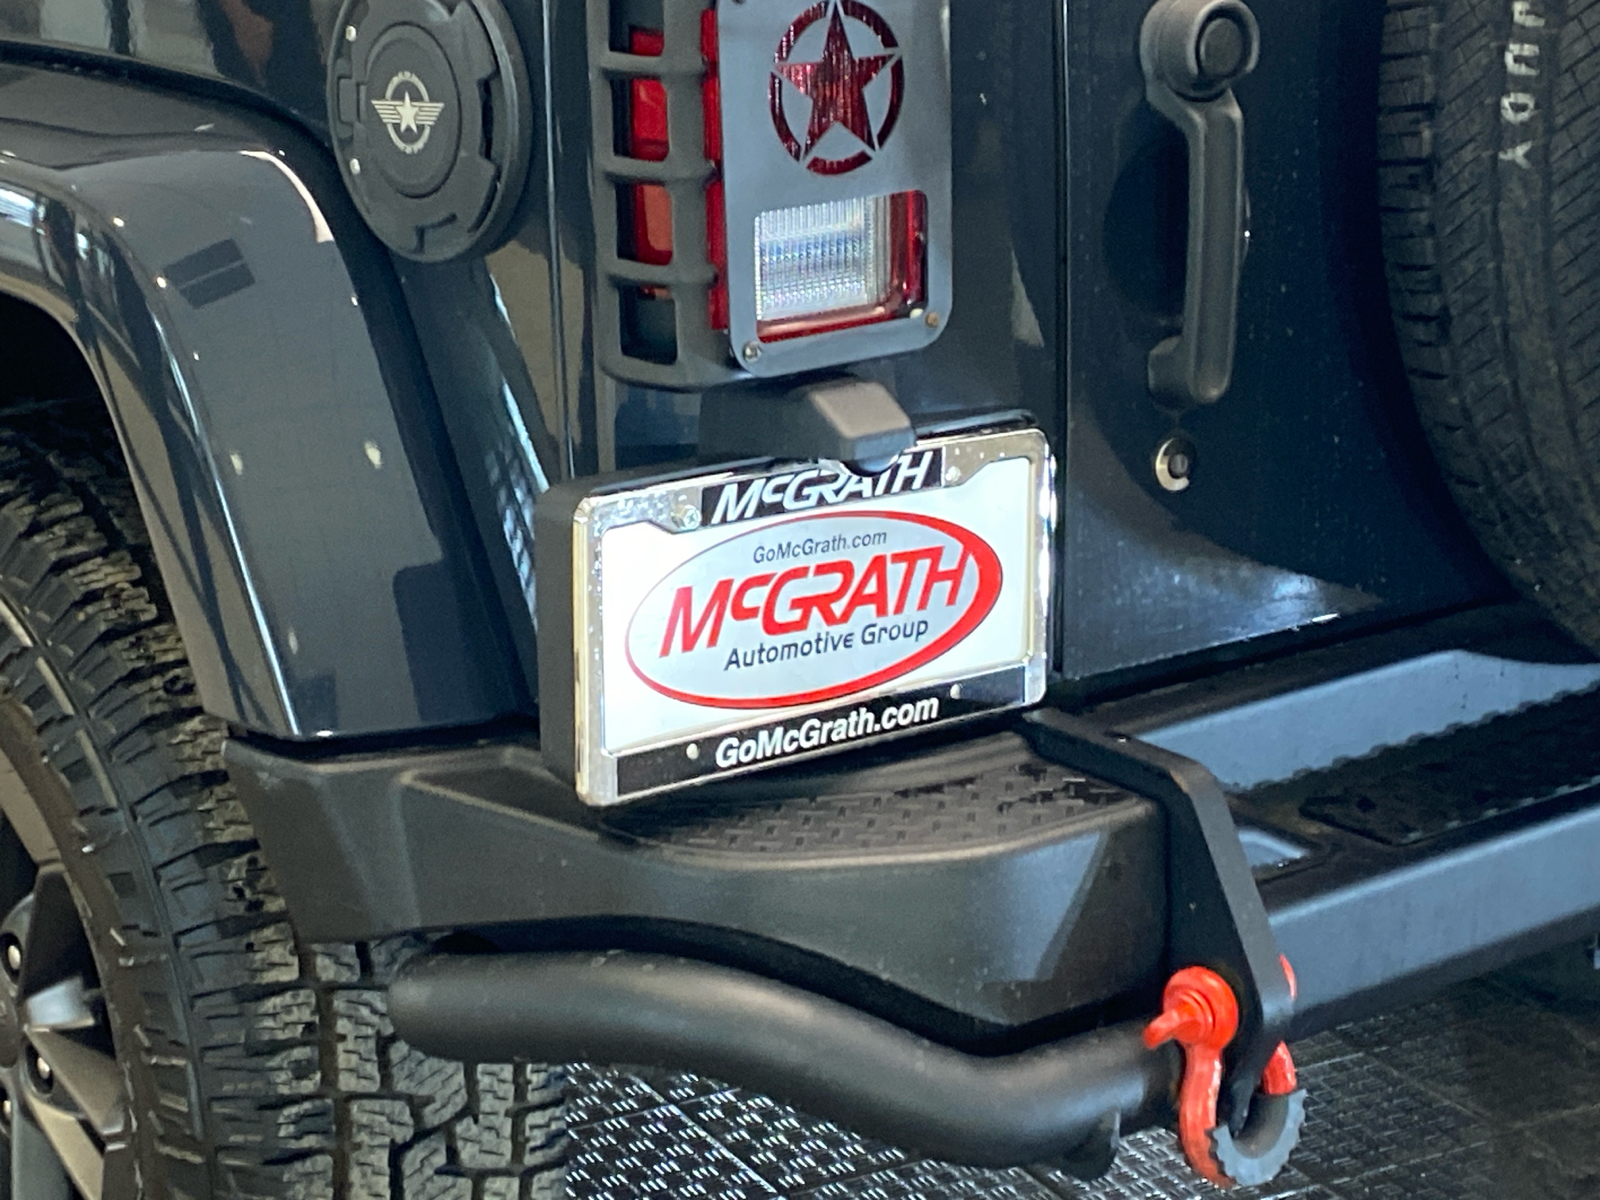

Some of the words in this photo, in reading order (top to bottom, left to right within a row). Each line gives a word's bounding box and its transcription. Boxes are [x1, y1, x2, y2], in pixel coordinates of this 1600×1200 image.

[752, 530, 888, 565] GoMcGrath.com
[723, 631, 855, 671] Automotive
[861, 618, 929, 647] Group
[714, 696, 940, 769] GoMcGrath.com
